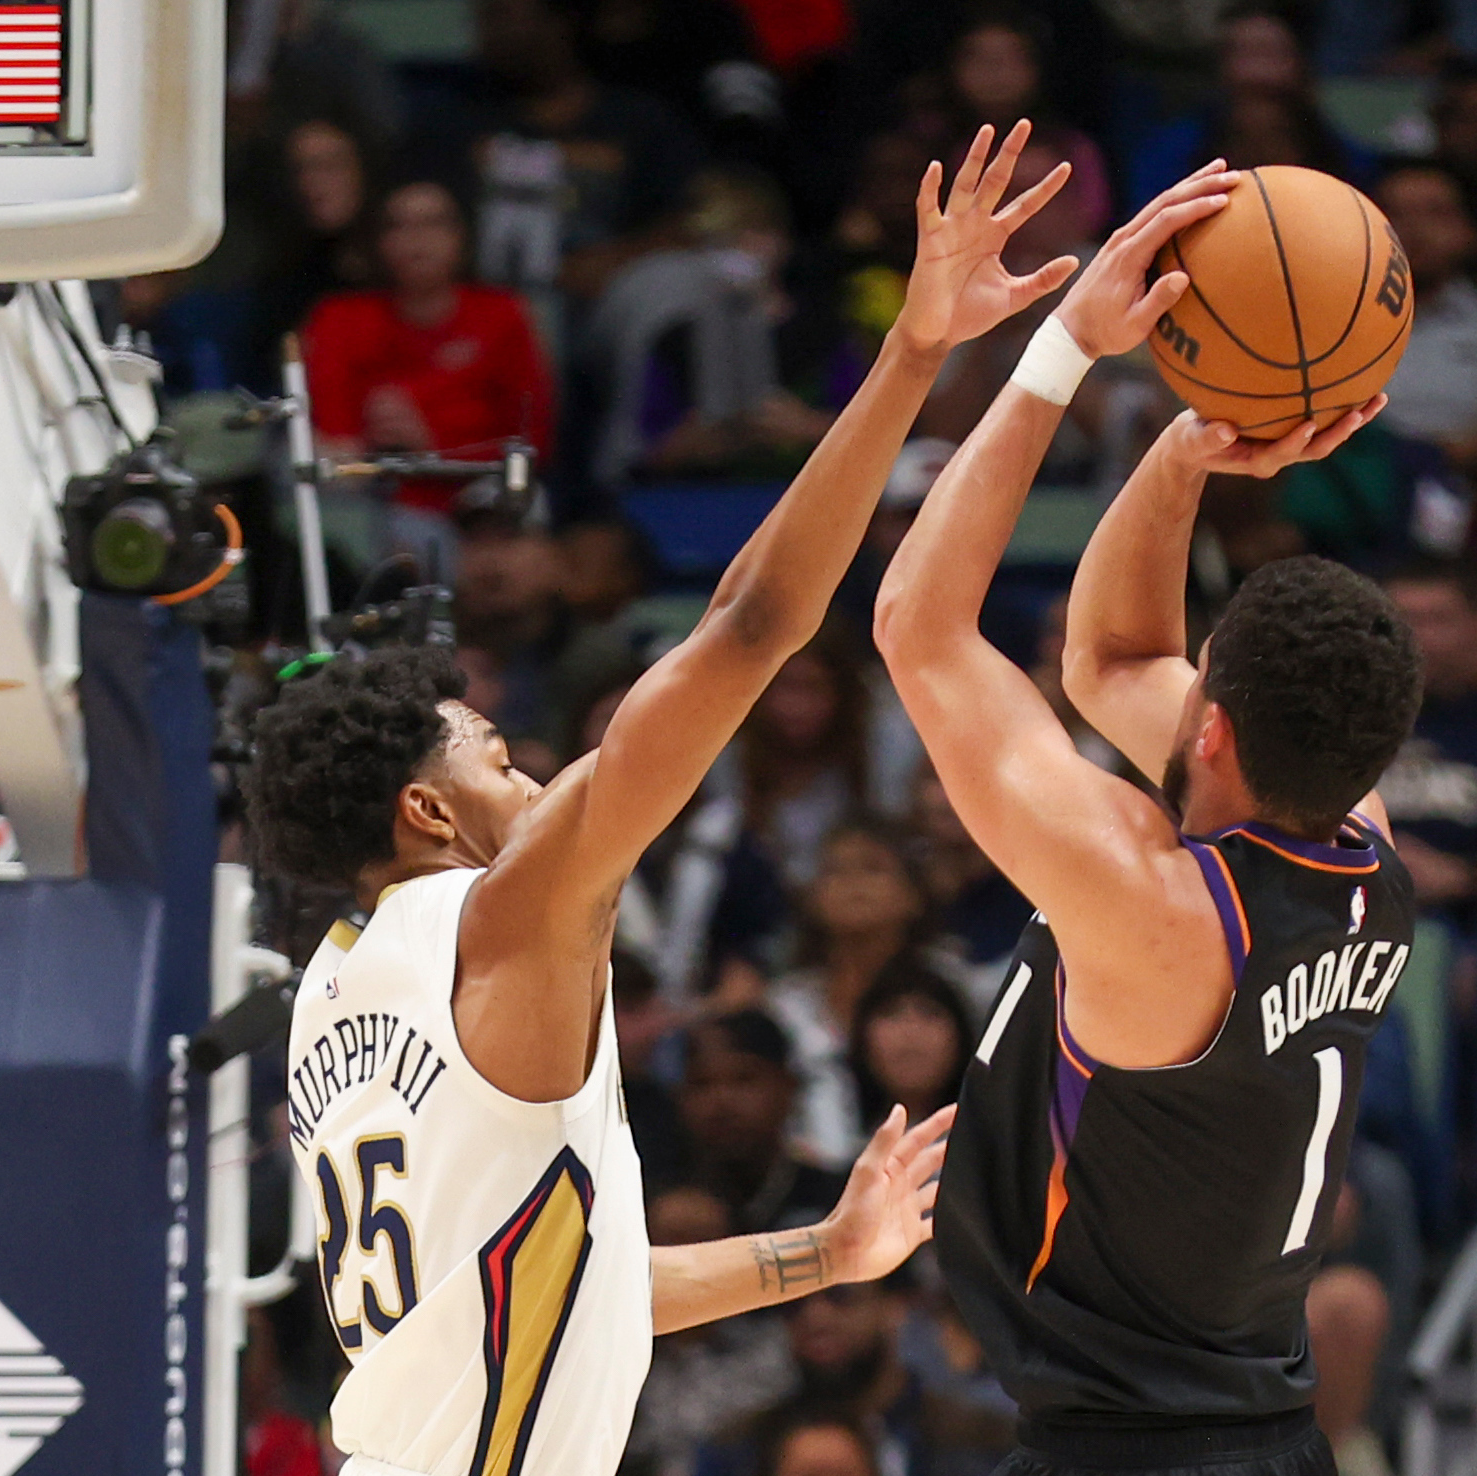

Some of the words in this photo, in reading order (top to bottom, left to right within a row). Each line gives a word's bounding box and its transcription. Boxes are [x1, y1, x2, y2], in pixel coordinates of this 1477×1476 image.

[288, 1013, 399, 1152] MURPHY
[390, 1026, 447, 1116] III
[1260, 940, 1410, 1057] BOOKER
[1281, 1046, 1343, 1257] 1
[315, 1130, 422, 1354] 25
